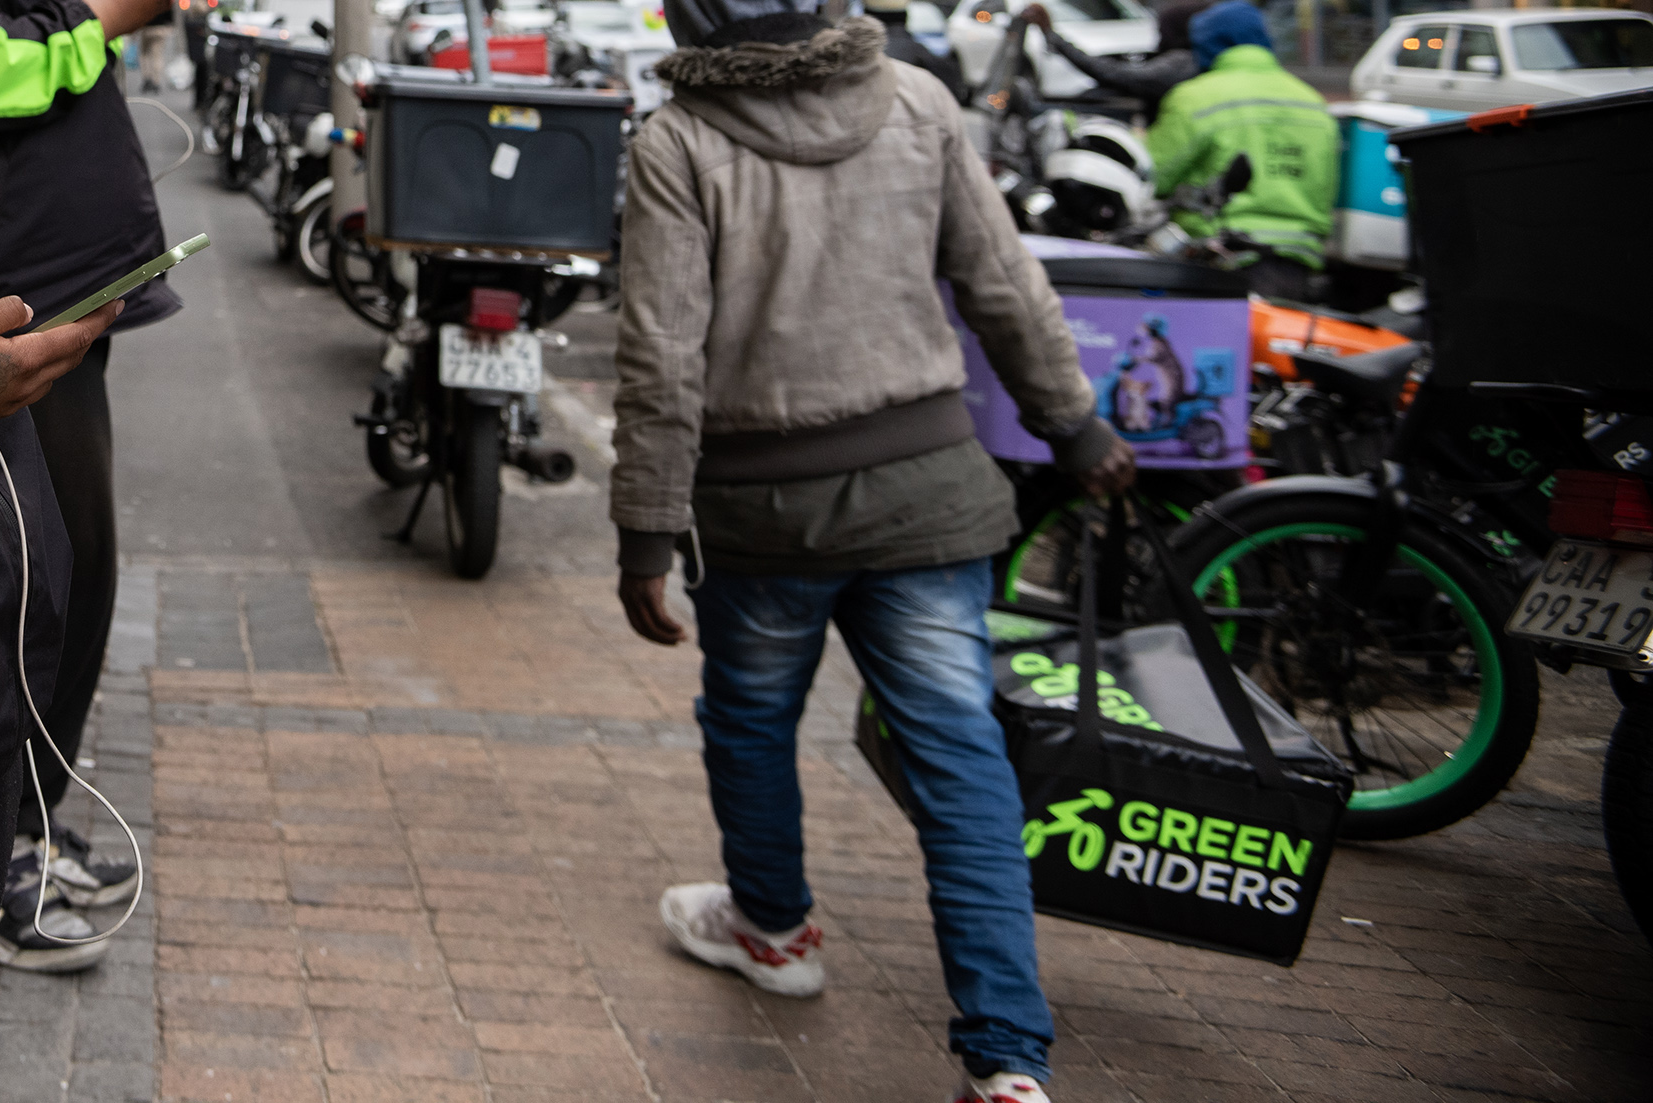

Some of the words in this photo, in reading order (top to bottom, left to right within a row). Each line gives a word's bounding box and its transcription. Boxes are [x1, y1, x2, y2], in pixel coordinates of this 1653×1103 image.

[1541, 547, 1618, 592] CAA
[1519, 592, 1651, 645] 99319
[1119, 801, 1313, 876] GREEN
[1106, 841, 1302, 915] RIDERS
